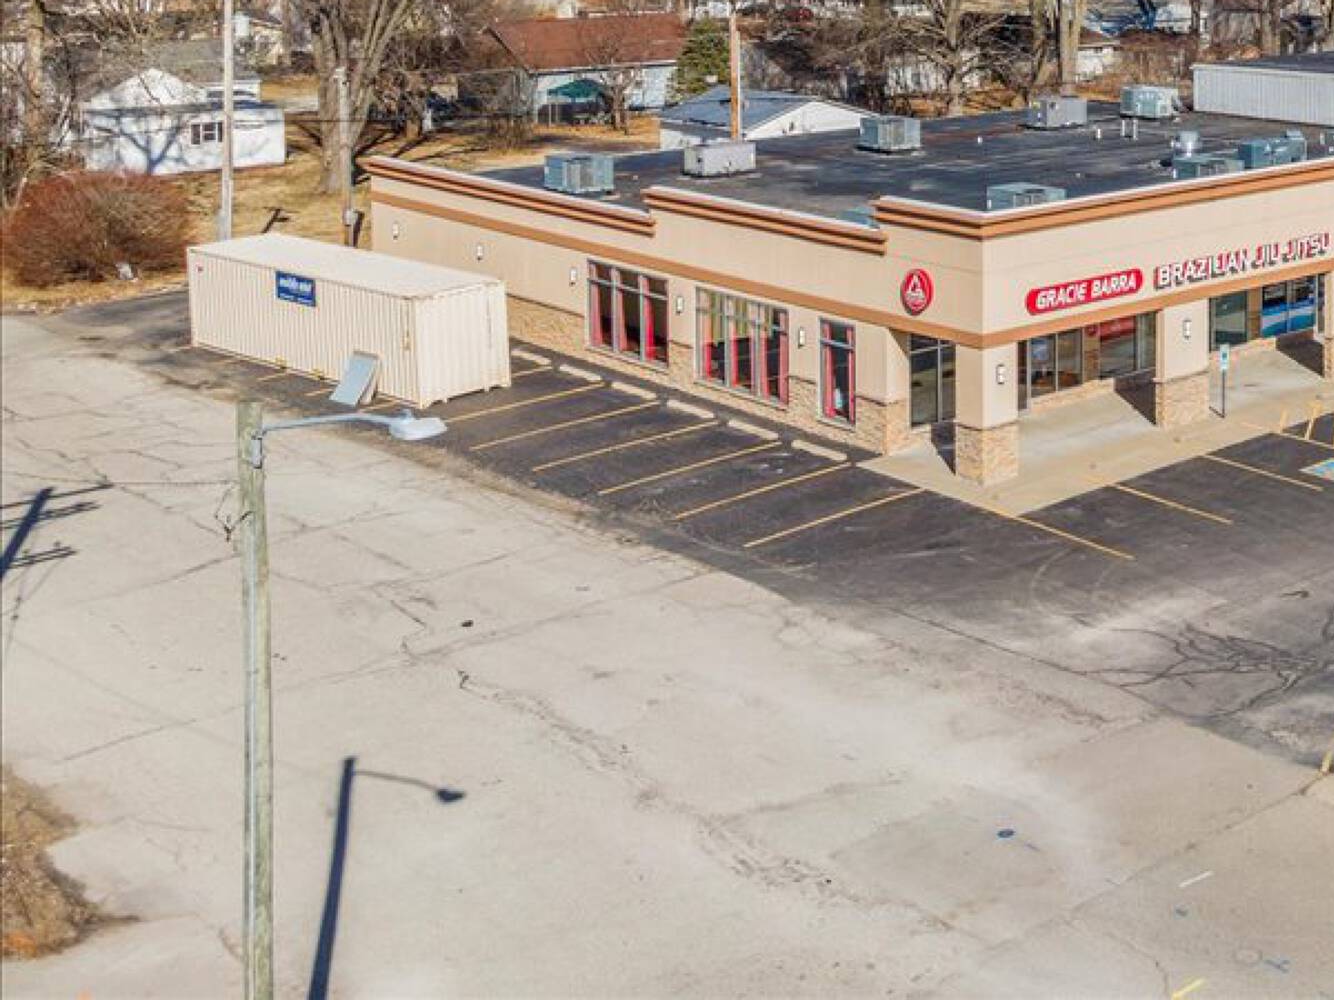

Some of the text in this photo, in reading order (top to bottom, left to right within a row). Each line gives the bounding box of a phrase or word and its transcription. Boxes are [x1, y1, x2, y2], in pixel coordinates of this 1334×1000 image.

[1156, 249, 1250, 289] BRAZILIAN
[1036, 272, 1137, 310] GRACIE BARRA
